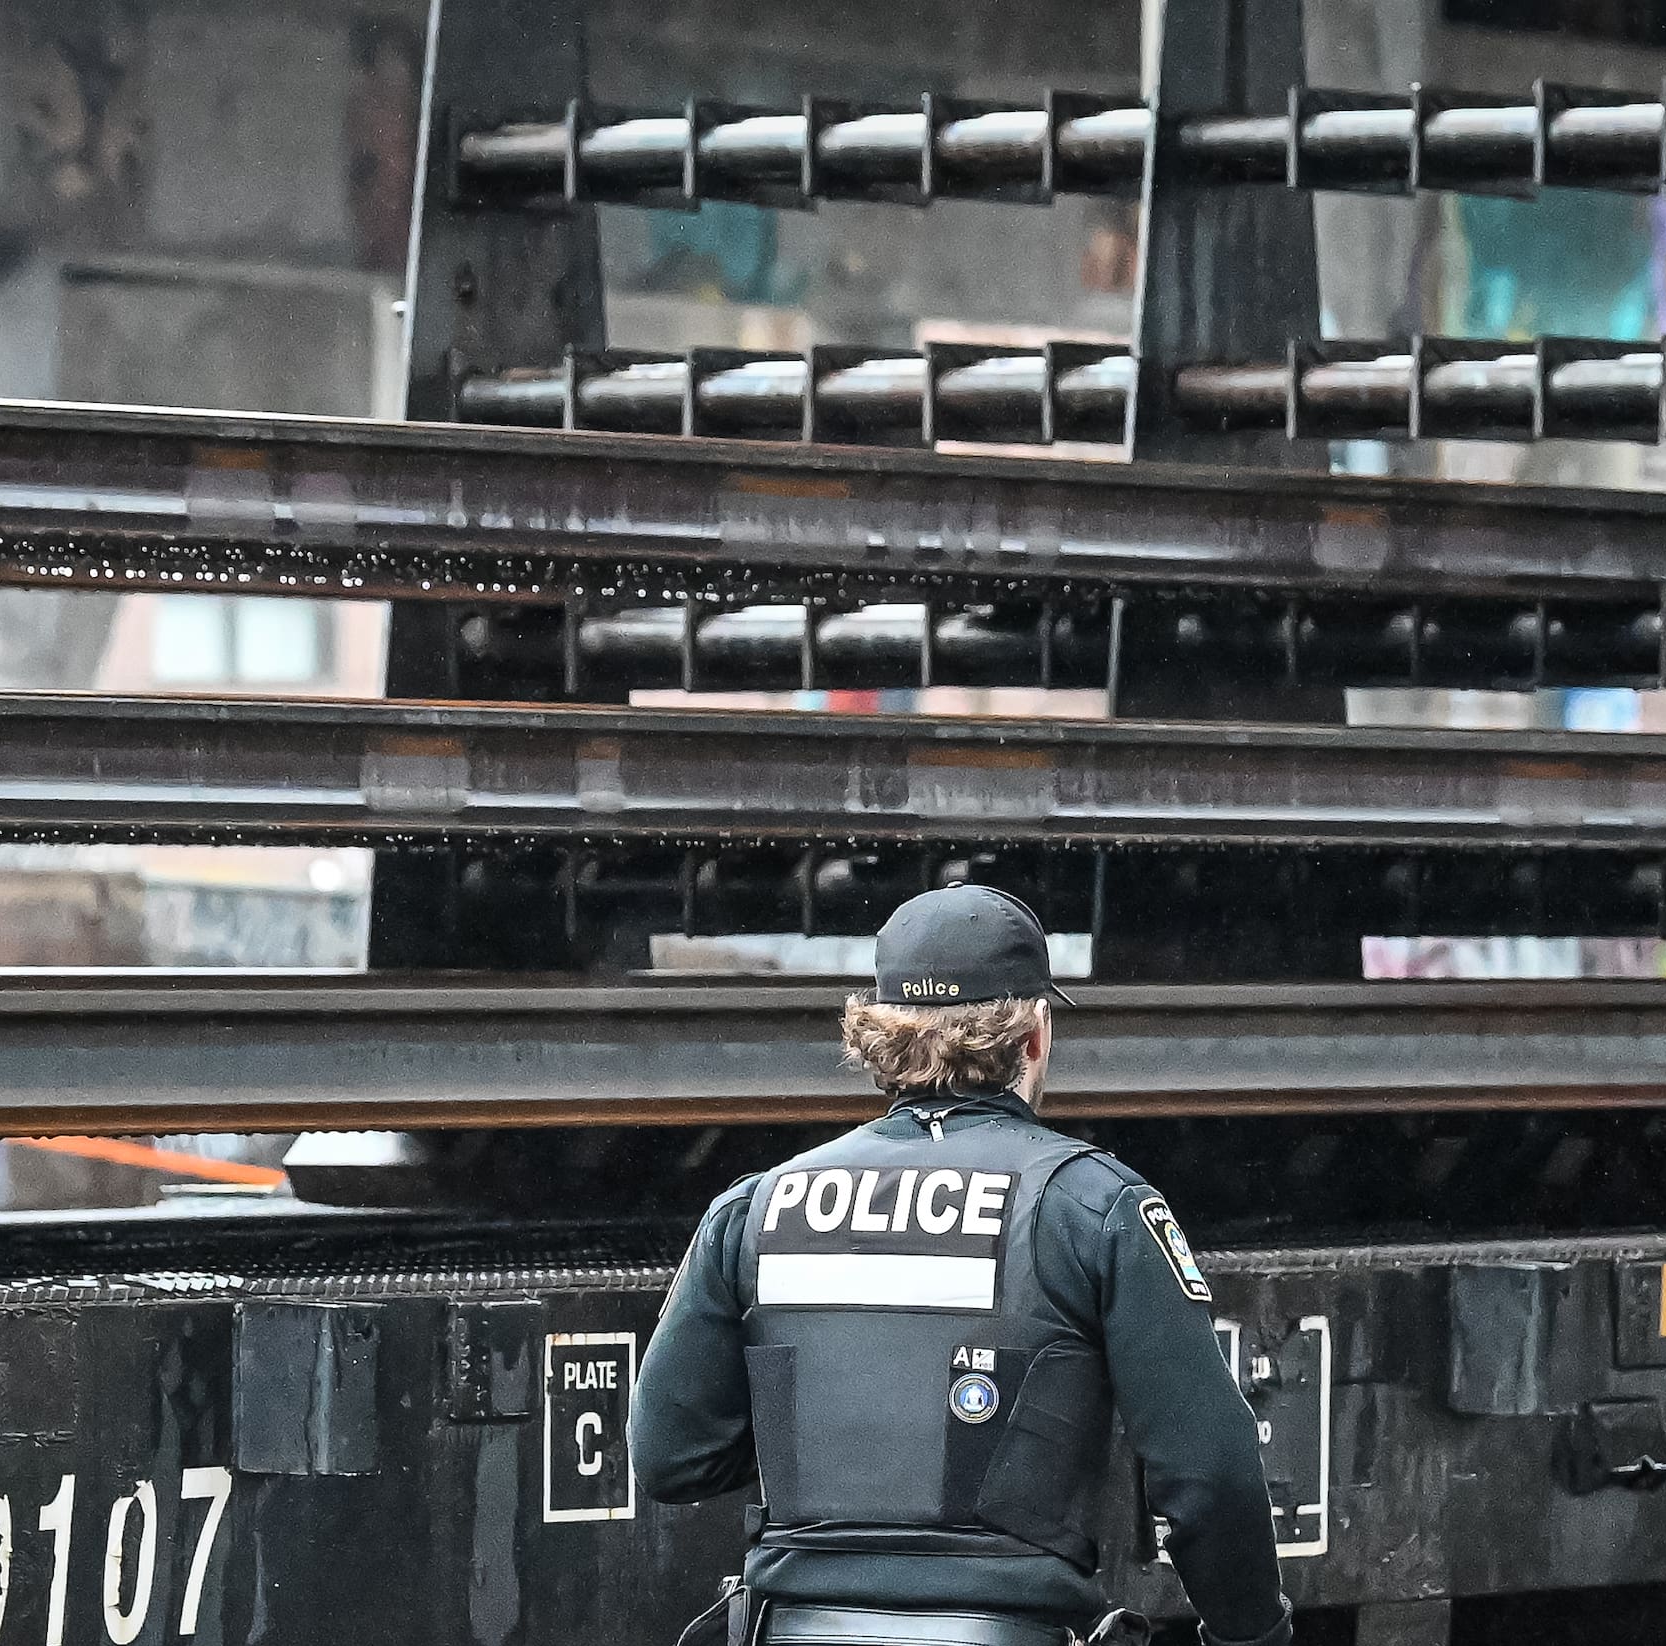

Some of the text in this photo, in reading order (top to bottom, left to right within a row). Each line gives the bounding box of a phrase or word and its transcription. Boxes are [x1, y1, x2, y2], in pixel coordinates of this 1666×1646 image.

[901, 977, 960, 999] Police
[762, 1167, 1013, 1236] POLICE
[563, 1360, 618, 1391] PLATE
[575, 1411, 603, 1476] C
